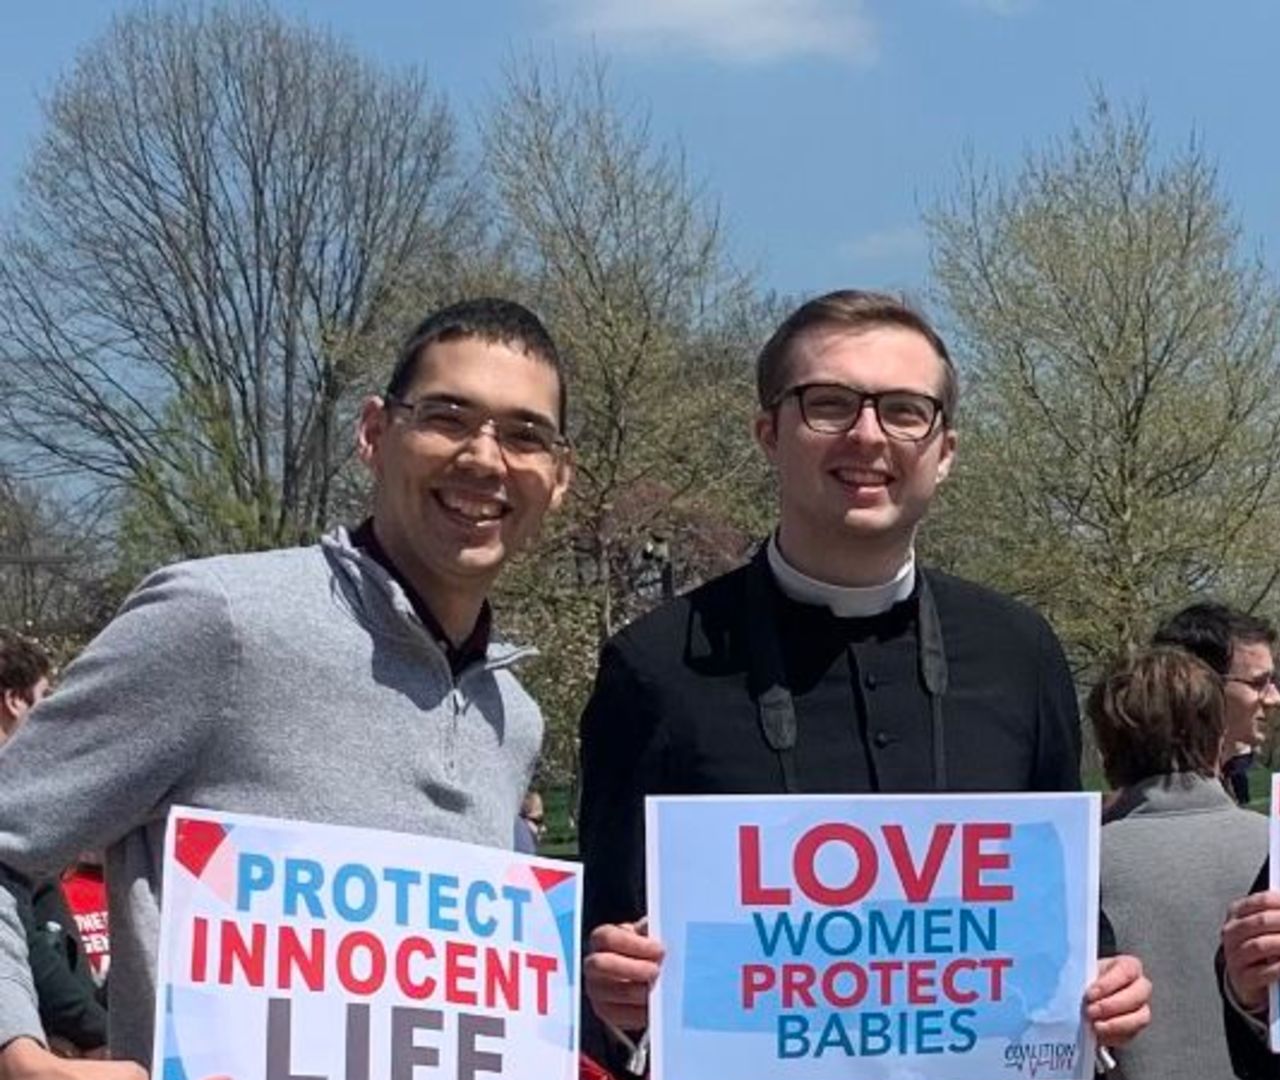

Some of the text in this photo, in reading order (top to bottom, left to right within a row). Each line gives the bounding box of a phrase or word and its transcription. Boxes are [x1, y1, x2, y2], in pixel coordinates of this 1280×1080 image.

[236, 852, 531, 941] PROTECT
[738, 822, 1014, 906] LOVE
[191, 916, 558, 1015] INNOCENT
[752, 907, 997, 957] WOMEN
[741, 958, 1014, 1009] PROTECT
[777, 1008, 977, 1059] BABIES
